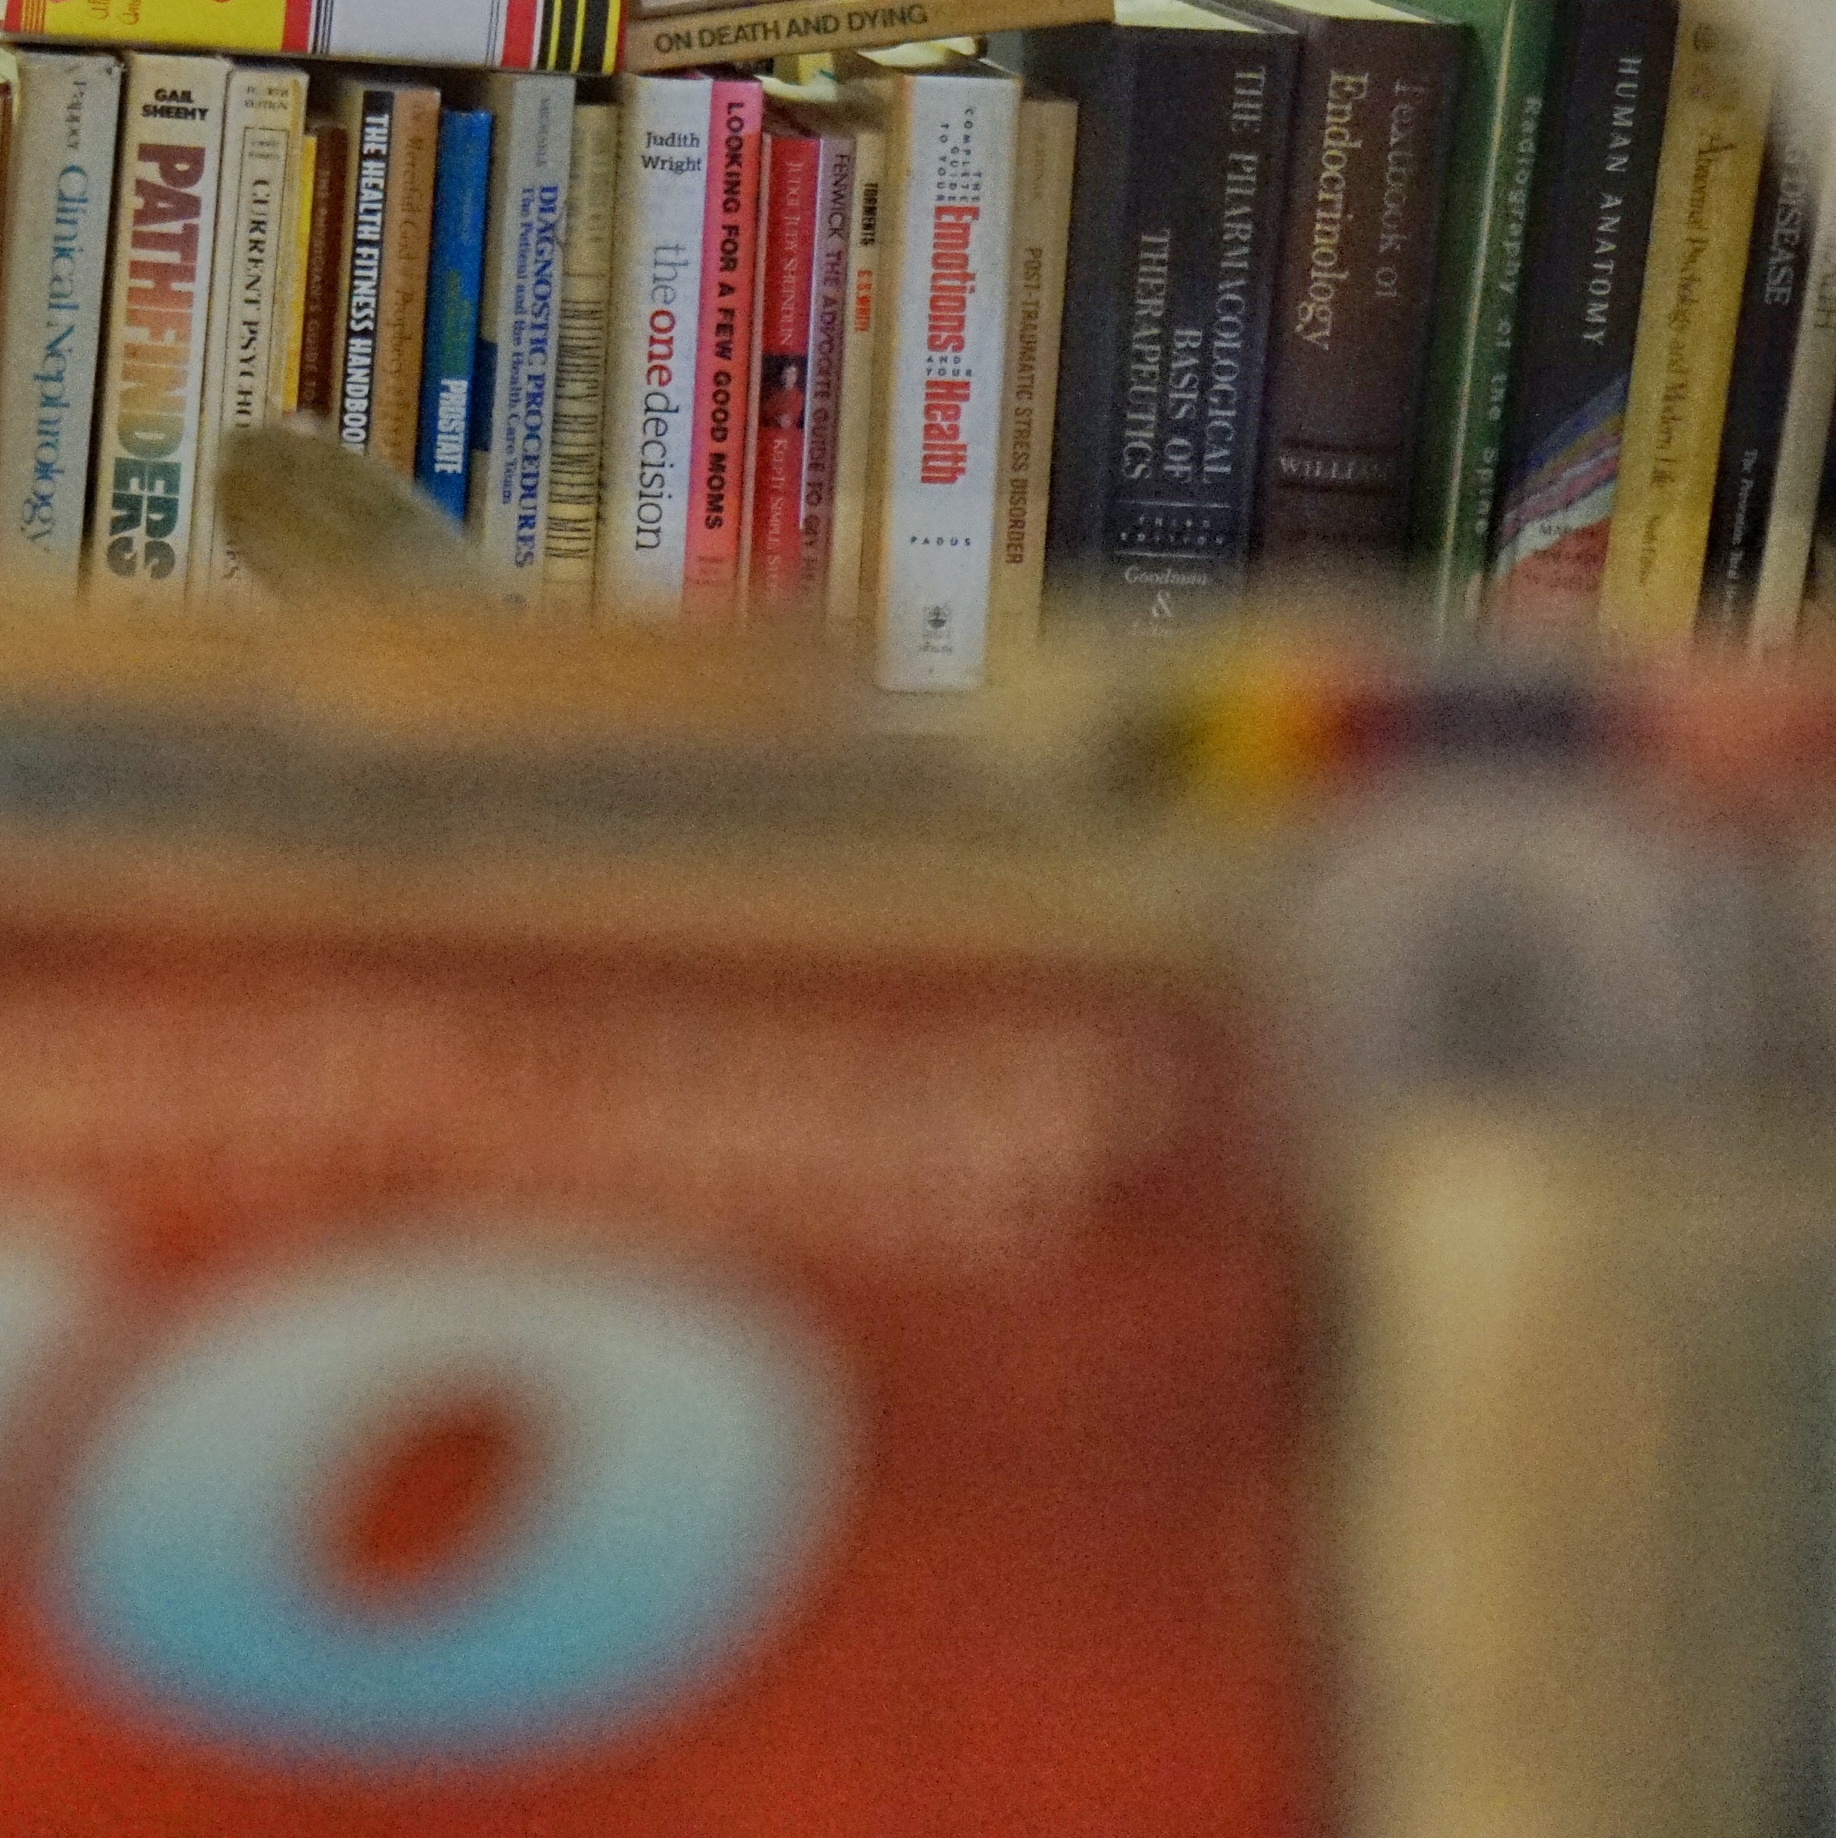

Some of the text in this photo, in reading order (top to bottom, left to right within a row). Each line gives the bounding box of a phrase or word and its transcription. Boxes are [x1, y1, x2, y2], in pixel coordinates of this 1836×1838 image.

[154, 87, 194, 104] GAIL
[653, 4, 929, 55] ON DEATH AND DYING
[141, 104, 209, 122] SHEEHY
[641, 154, 702, 175] Wright
[645, 130, 702, 151] Judith
[244, 180, 271, 311] CURRENT
[350, 113, 389, 332] THE HEALTH FITNESS
[823, 153, 849, 285] FENWICK THE
[1202, 65, 1266, 483] THE PHARMACOLOGICAL
[1295, 69, 1370, 352] Endocrinology
[1583, 55, 1643, 346] HUMAN ANATOMY
[21, 165, 89, 544] Clinical Nephrology
[706, 102, 745, 530] LOOKING FOR A FEW GOOD MOMS
[926, 205, 981, 353] Emotions
[1122, 229, 1171, 480] THERAPEUTICS
[106, 142, 206, 581] PATHFINDERS
[434, 378, 469, 474] PROSTATE
[514, 185, 558, 568] DIAGNOSTIC PROCEDURES
[921, 380, 972, 485] Health
[1005, 247, 1043, 564] POST-TRAUMATIC STRESS DISORDER
[1164, 328, 1204, 482] BASIS OF
